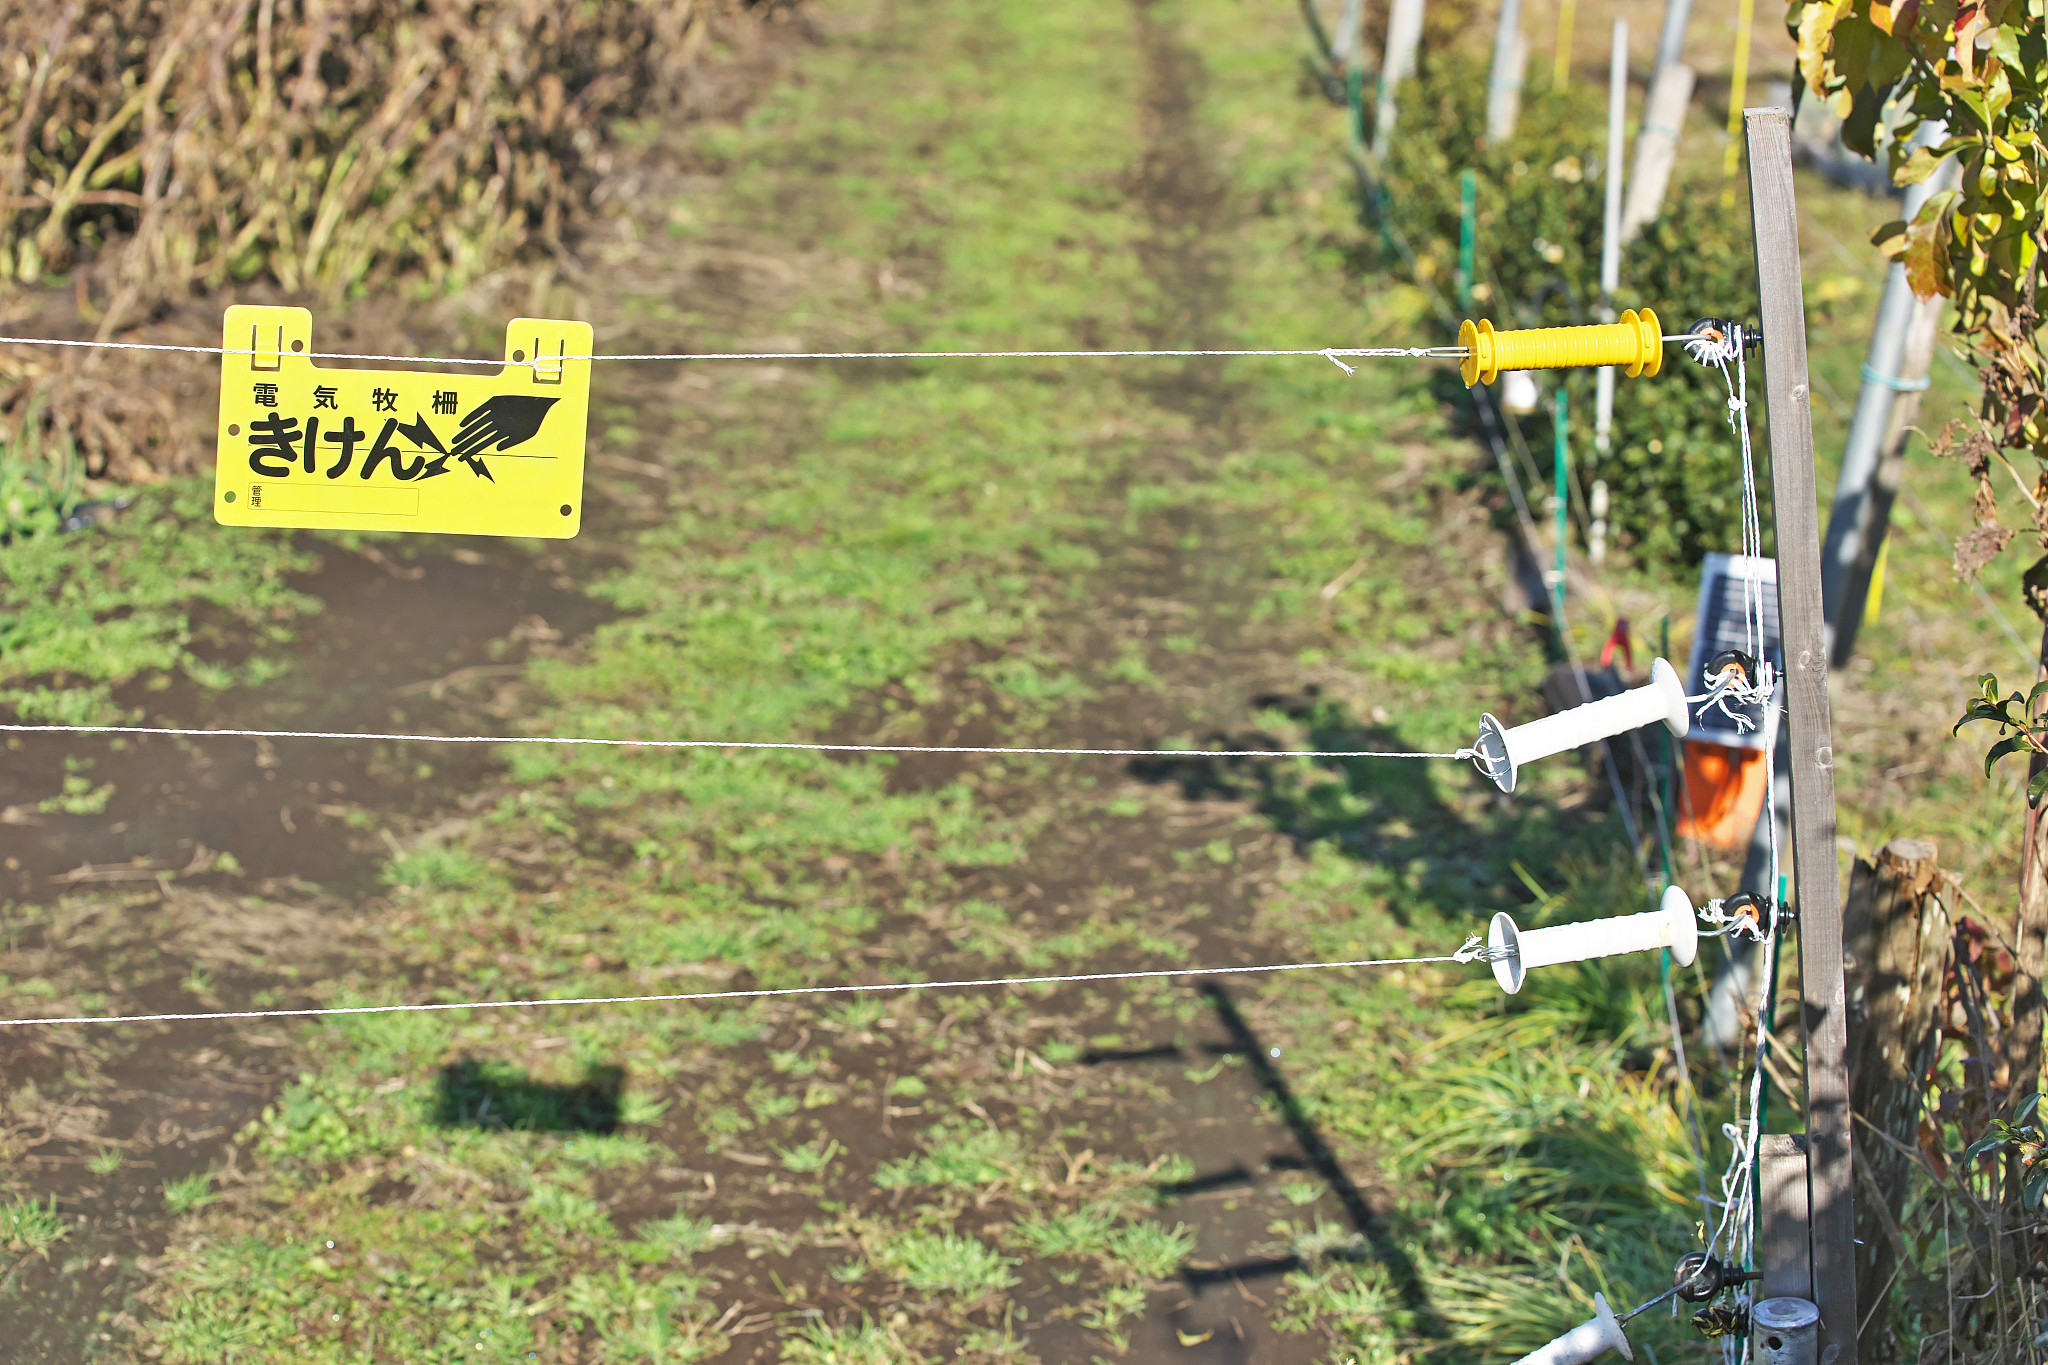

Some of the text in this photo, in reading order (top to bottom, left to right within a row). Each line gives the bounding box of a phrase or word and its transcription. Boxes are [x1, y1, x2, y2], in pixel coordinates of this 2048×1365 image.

[253, 382, 458, 415] 電気牧柵
[248, 412, 426, 480] きけん
[251, 485, 262, 508] 管理
